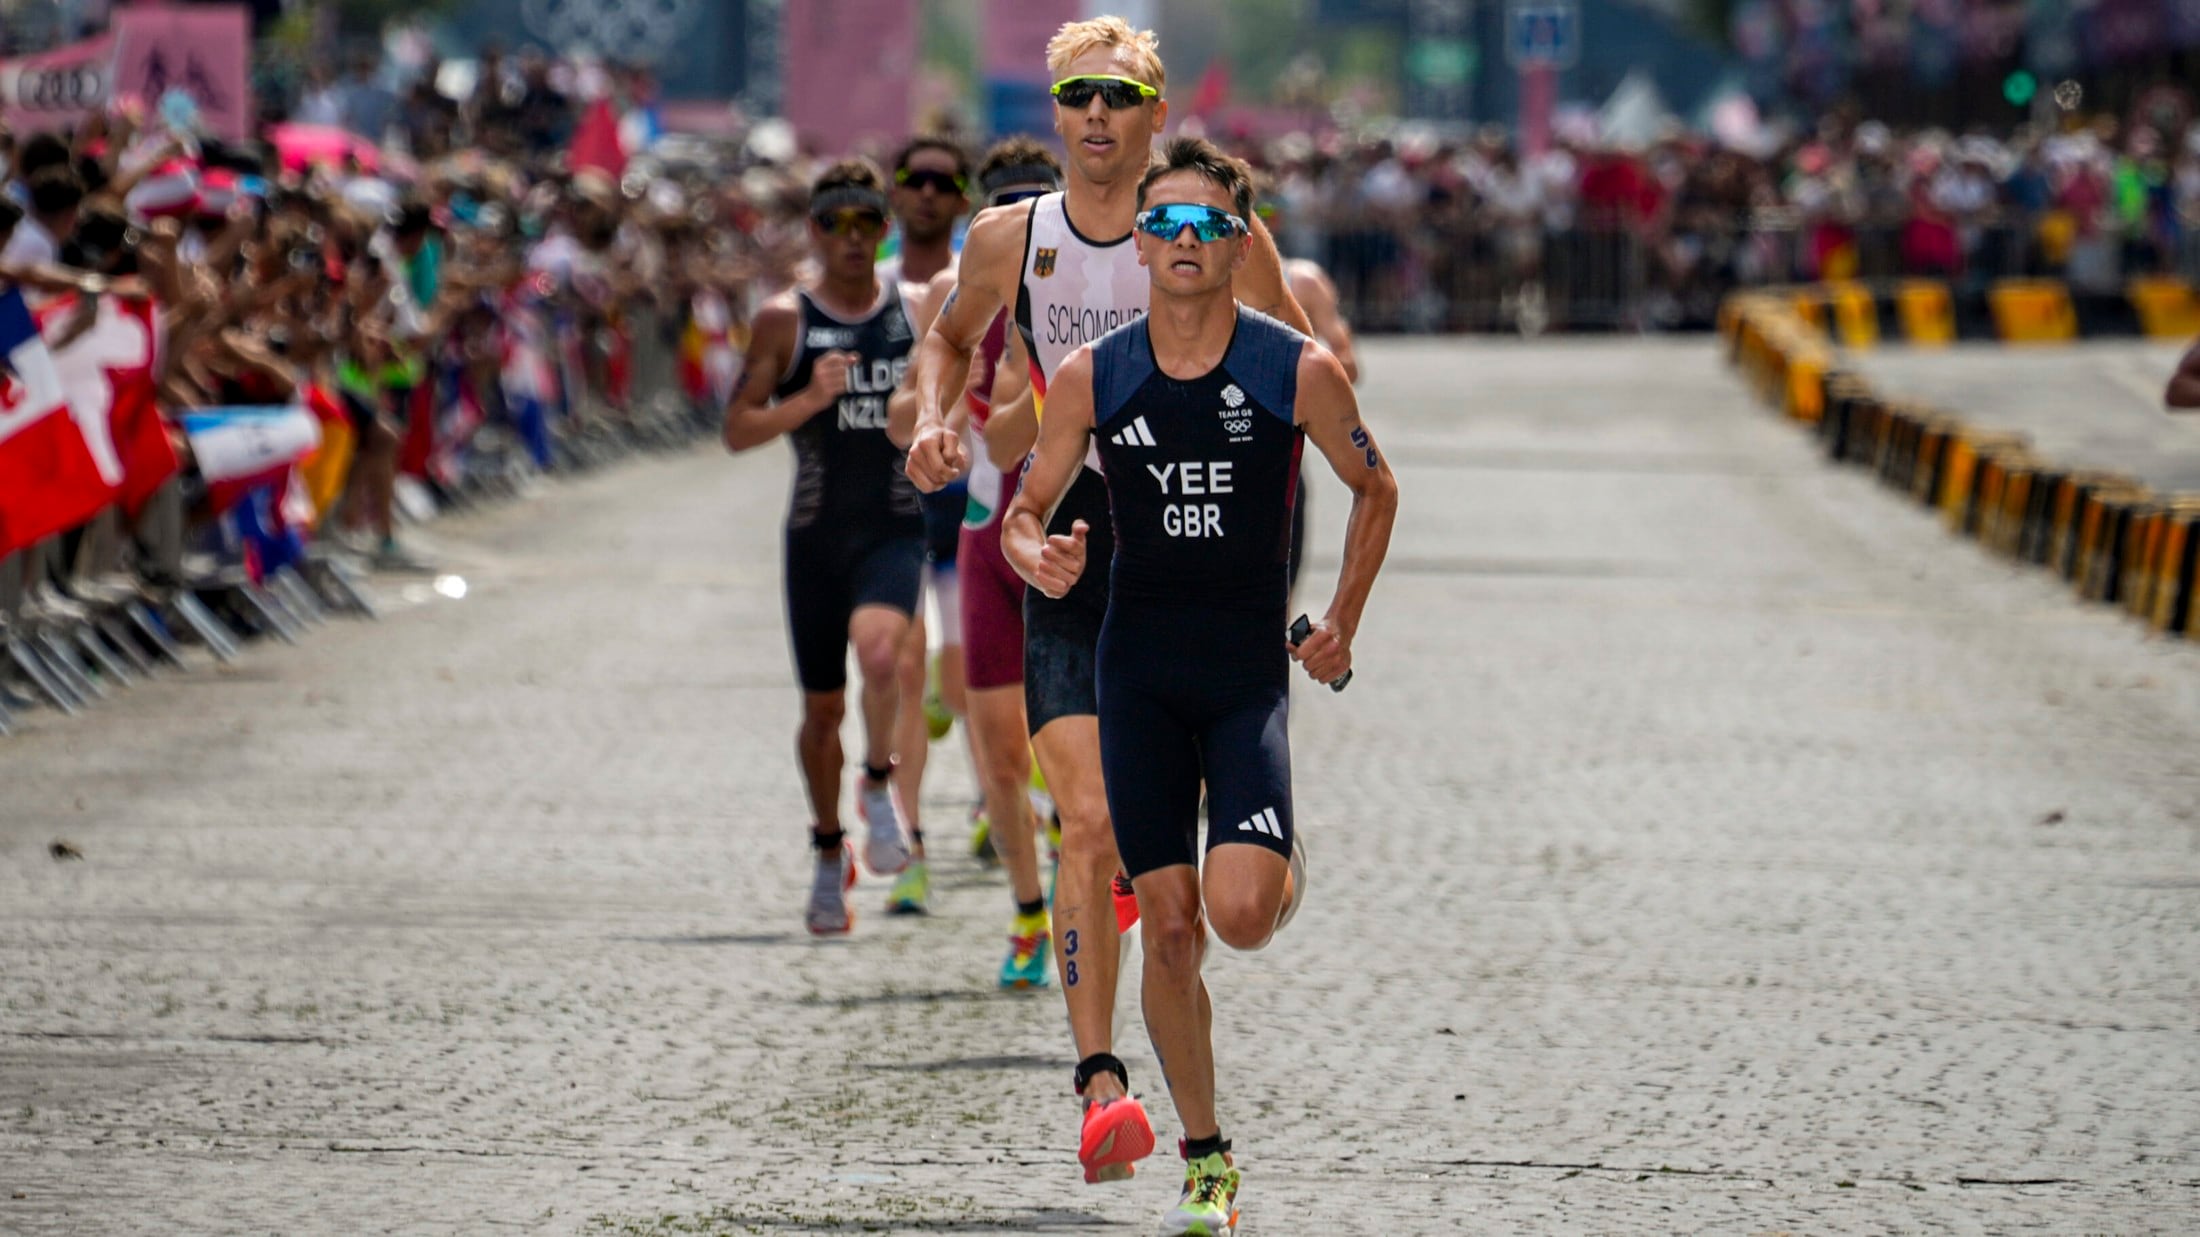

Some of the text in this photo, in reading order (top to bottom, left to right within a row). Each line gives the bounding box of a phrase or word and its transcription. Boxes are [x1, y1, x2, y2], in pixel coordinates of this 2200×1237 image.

[845, 357, 909, 393] ILDE
[838, 397, 889, 431] NZL
[1218, 408, 1253, 419] TEAM GB
[1146, 461, 1233, 495] YEE
[1163, 503, 1224, 538] GBR
